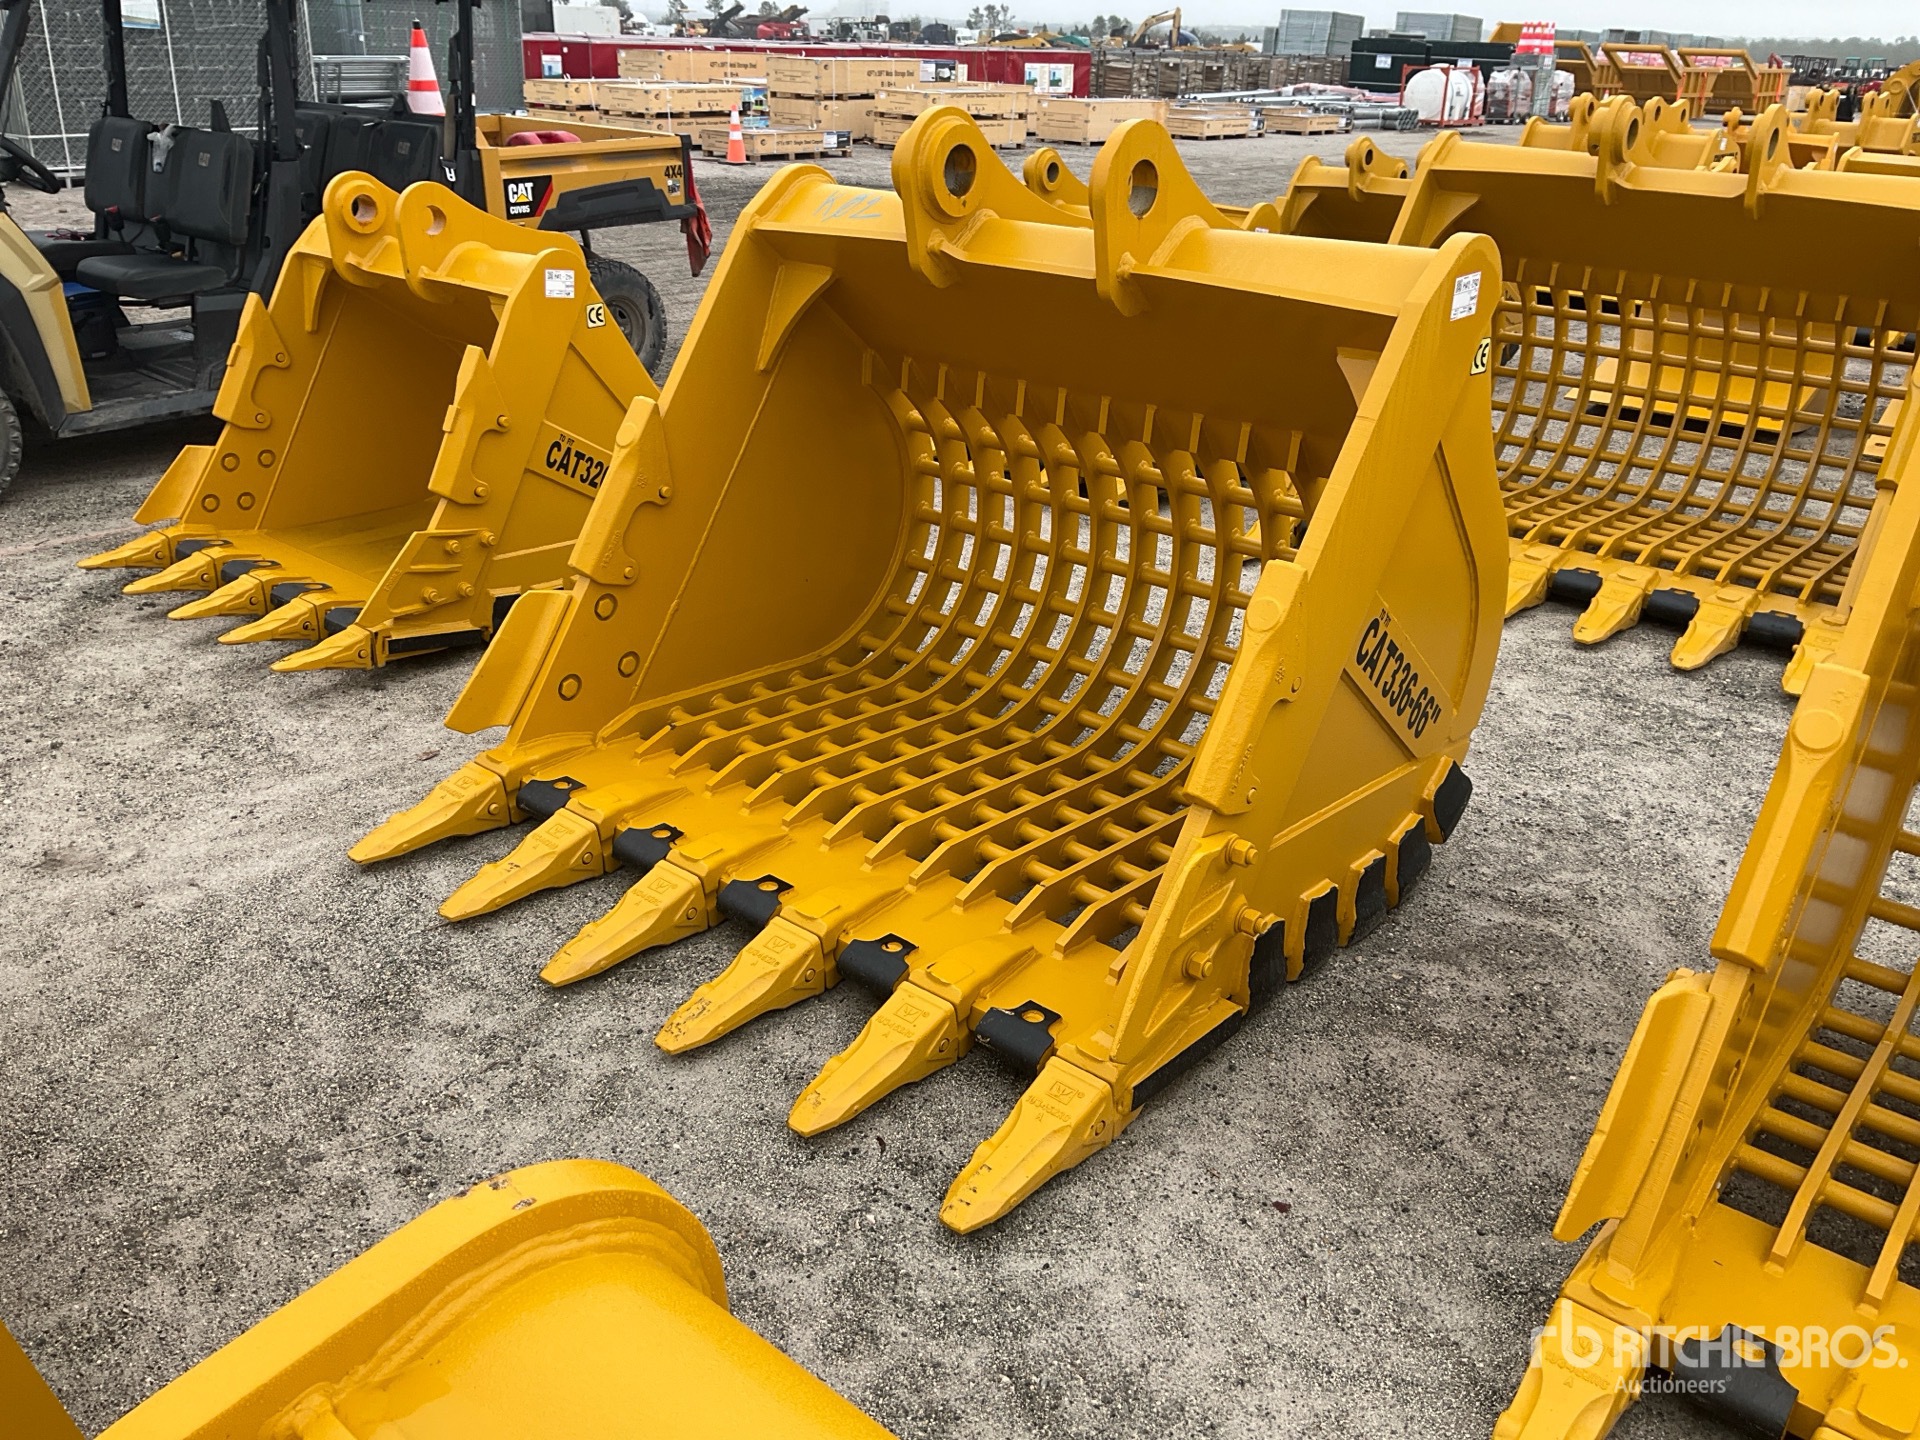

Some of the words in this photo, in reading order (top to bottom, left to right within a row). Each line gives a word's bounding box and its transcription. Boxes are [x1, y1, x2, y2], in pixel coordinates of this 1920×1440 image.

[664, 164, 683, 179] 4X4
[508, 182, 534, 204] CAT
[509, 204, 531, 215] CUV85
[588, 305, 604, 324] CE
[1474, 342, 1490, 369] CE
[558, 433, 566, 443] TO
[566, 437, 576, 447] FIT
[1355, 617, 1442, 740] CAT336-66"
